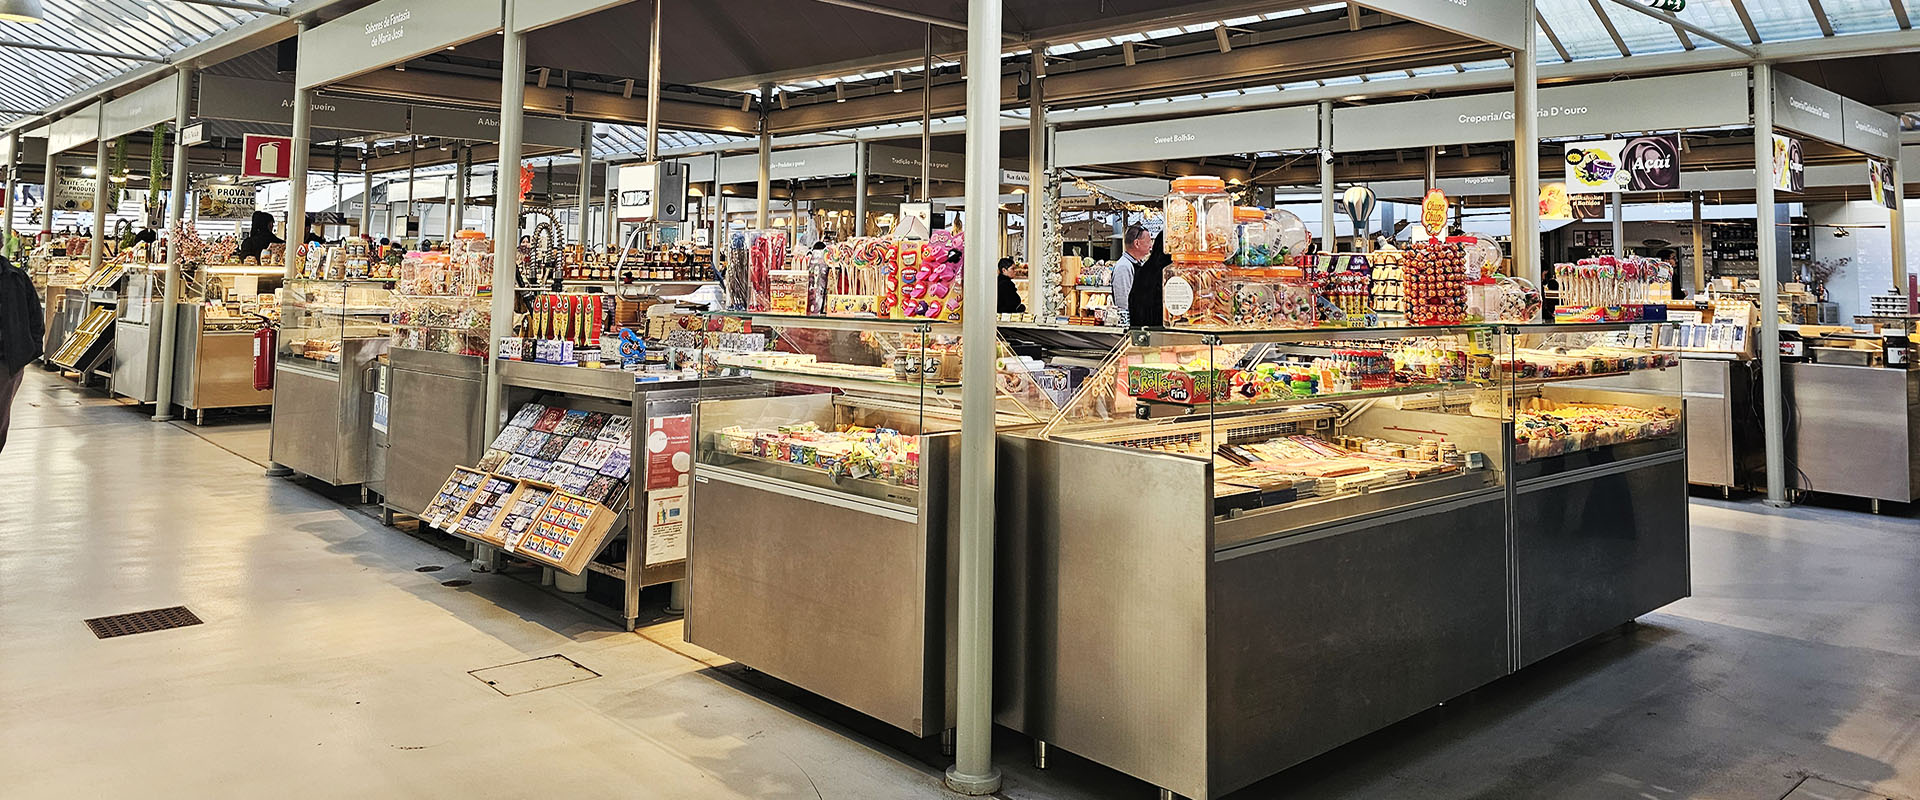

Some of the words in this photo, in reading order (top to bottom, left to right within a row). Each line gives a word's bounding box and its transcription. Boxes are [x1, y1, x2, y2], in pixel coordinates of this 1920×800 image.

[365, 20, 384, 35] Sabores
[384, 16, 390, 28] de
[390, 8, 410, 25] Fantasia
[371, 36, 378, 47] de
[378, 31, 391, 45] Maria
[392, 26, 404, 40] José
[282, 99, 288, 107] A
[1154, 136, 1173, 144] Sweet
[1174, 133, 1195, 142] Bolhão
[1632, 154, 1670, 173] Açaí
[1140, 372, 1175, 394] Roller
